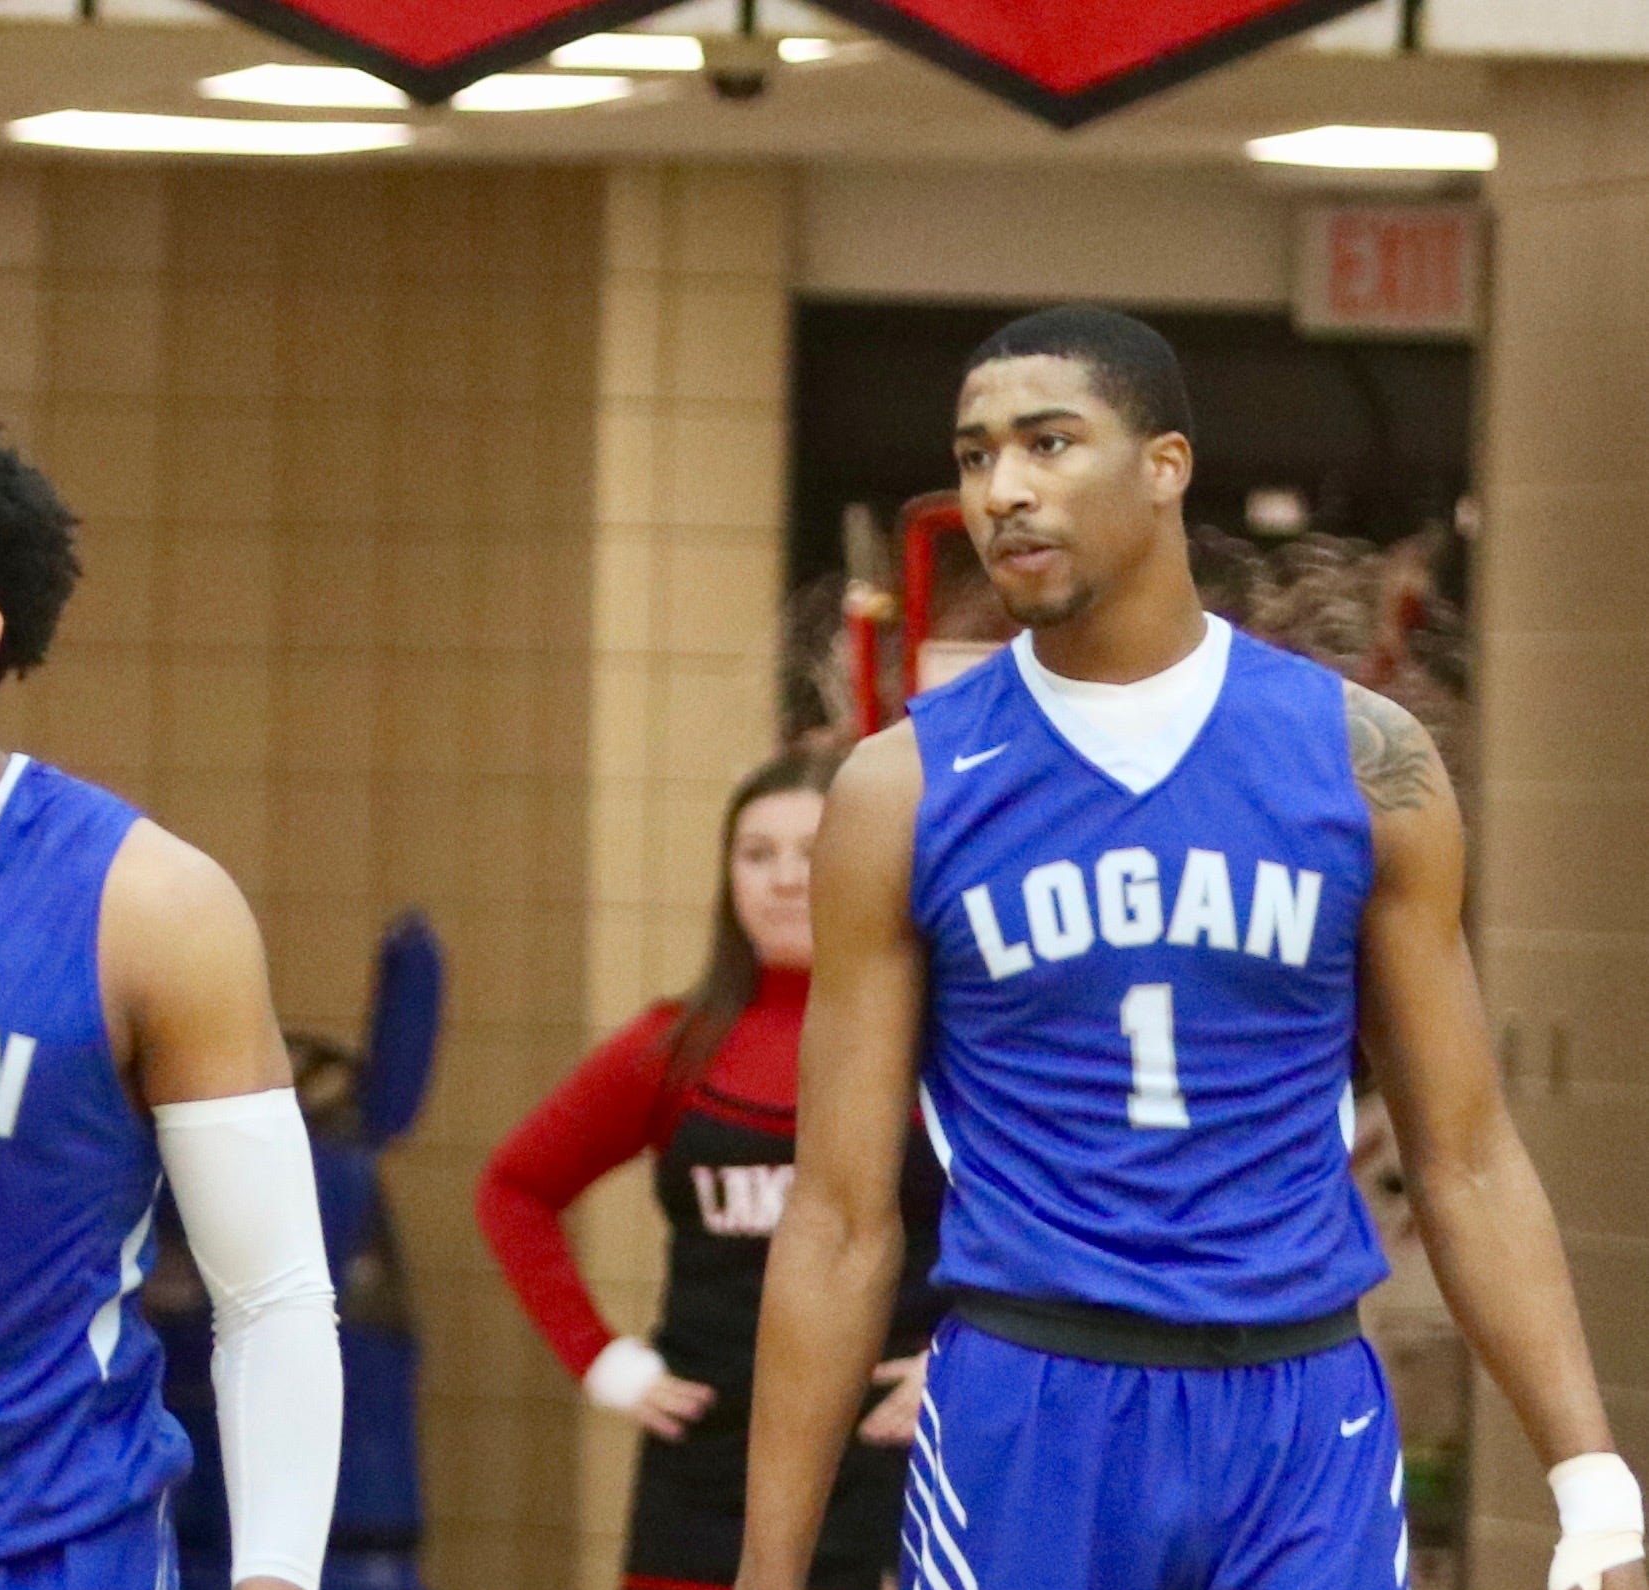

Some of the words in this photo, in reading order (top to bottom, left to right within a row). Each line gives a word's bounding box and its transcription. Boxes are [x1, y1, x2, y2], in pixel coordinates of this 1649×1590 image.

[1328, 212, 1464, 318] EXIT
[961, 846, 1324, 981] LOGAN
[1118, 981, 1191, 1131] 1
